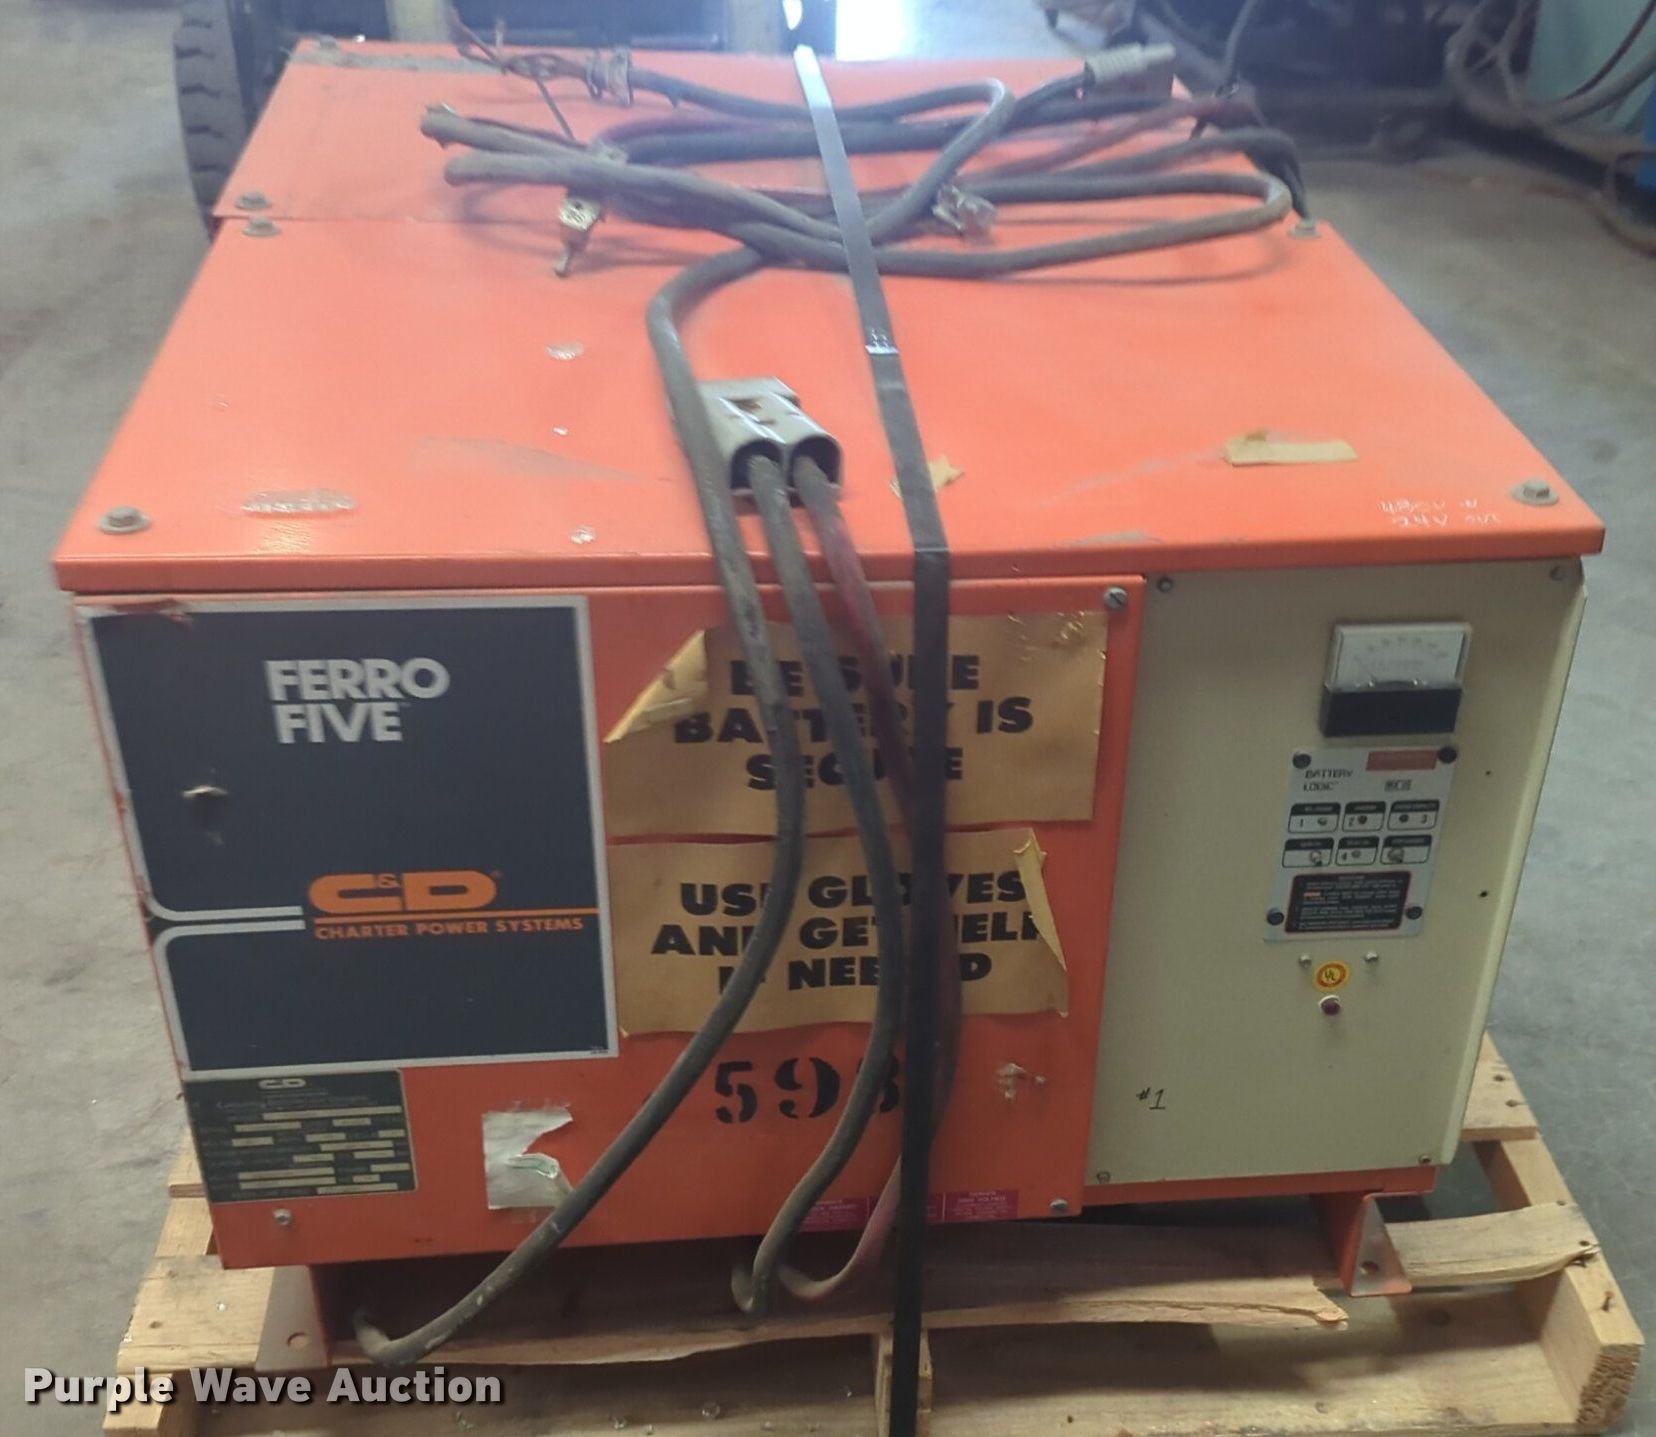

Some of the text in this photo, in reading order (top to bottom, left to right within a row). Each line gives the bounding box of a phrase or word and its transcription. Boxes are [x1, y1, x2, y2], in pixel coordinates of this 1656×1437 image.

[264, 657, 450, 701] FERRO
[274, 702, 403, 744] FIVE
[976, 695, 1034, 734] IS
[680, 882, 772, 916] US
[315, 917, 584, 940] CHARTER POWER SYSTEMS
[800, 916, 877, 949] GE
[788, 952, 992, 991] NEED
[1136, 1087, 1166, 1110] #1
